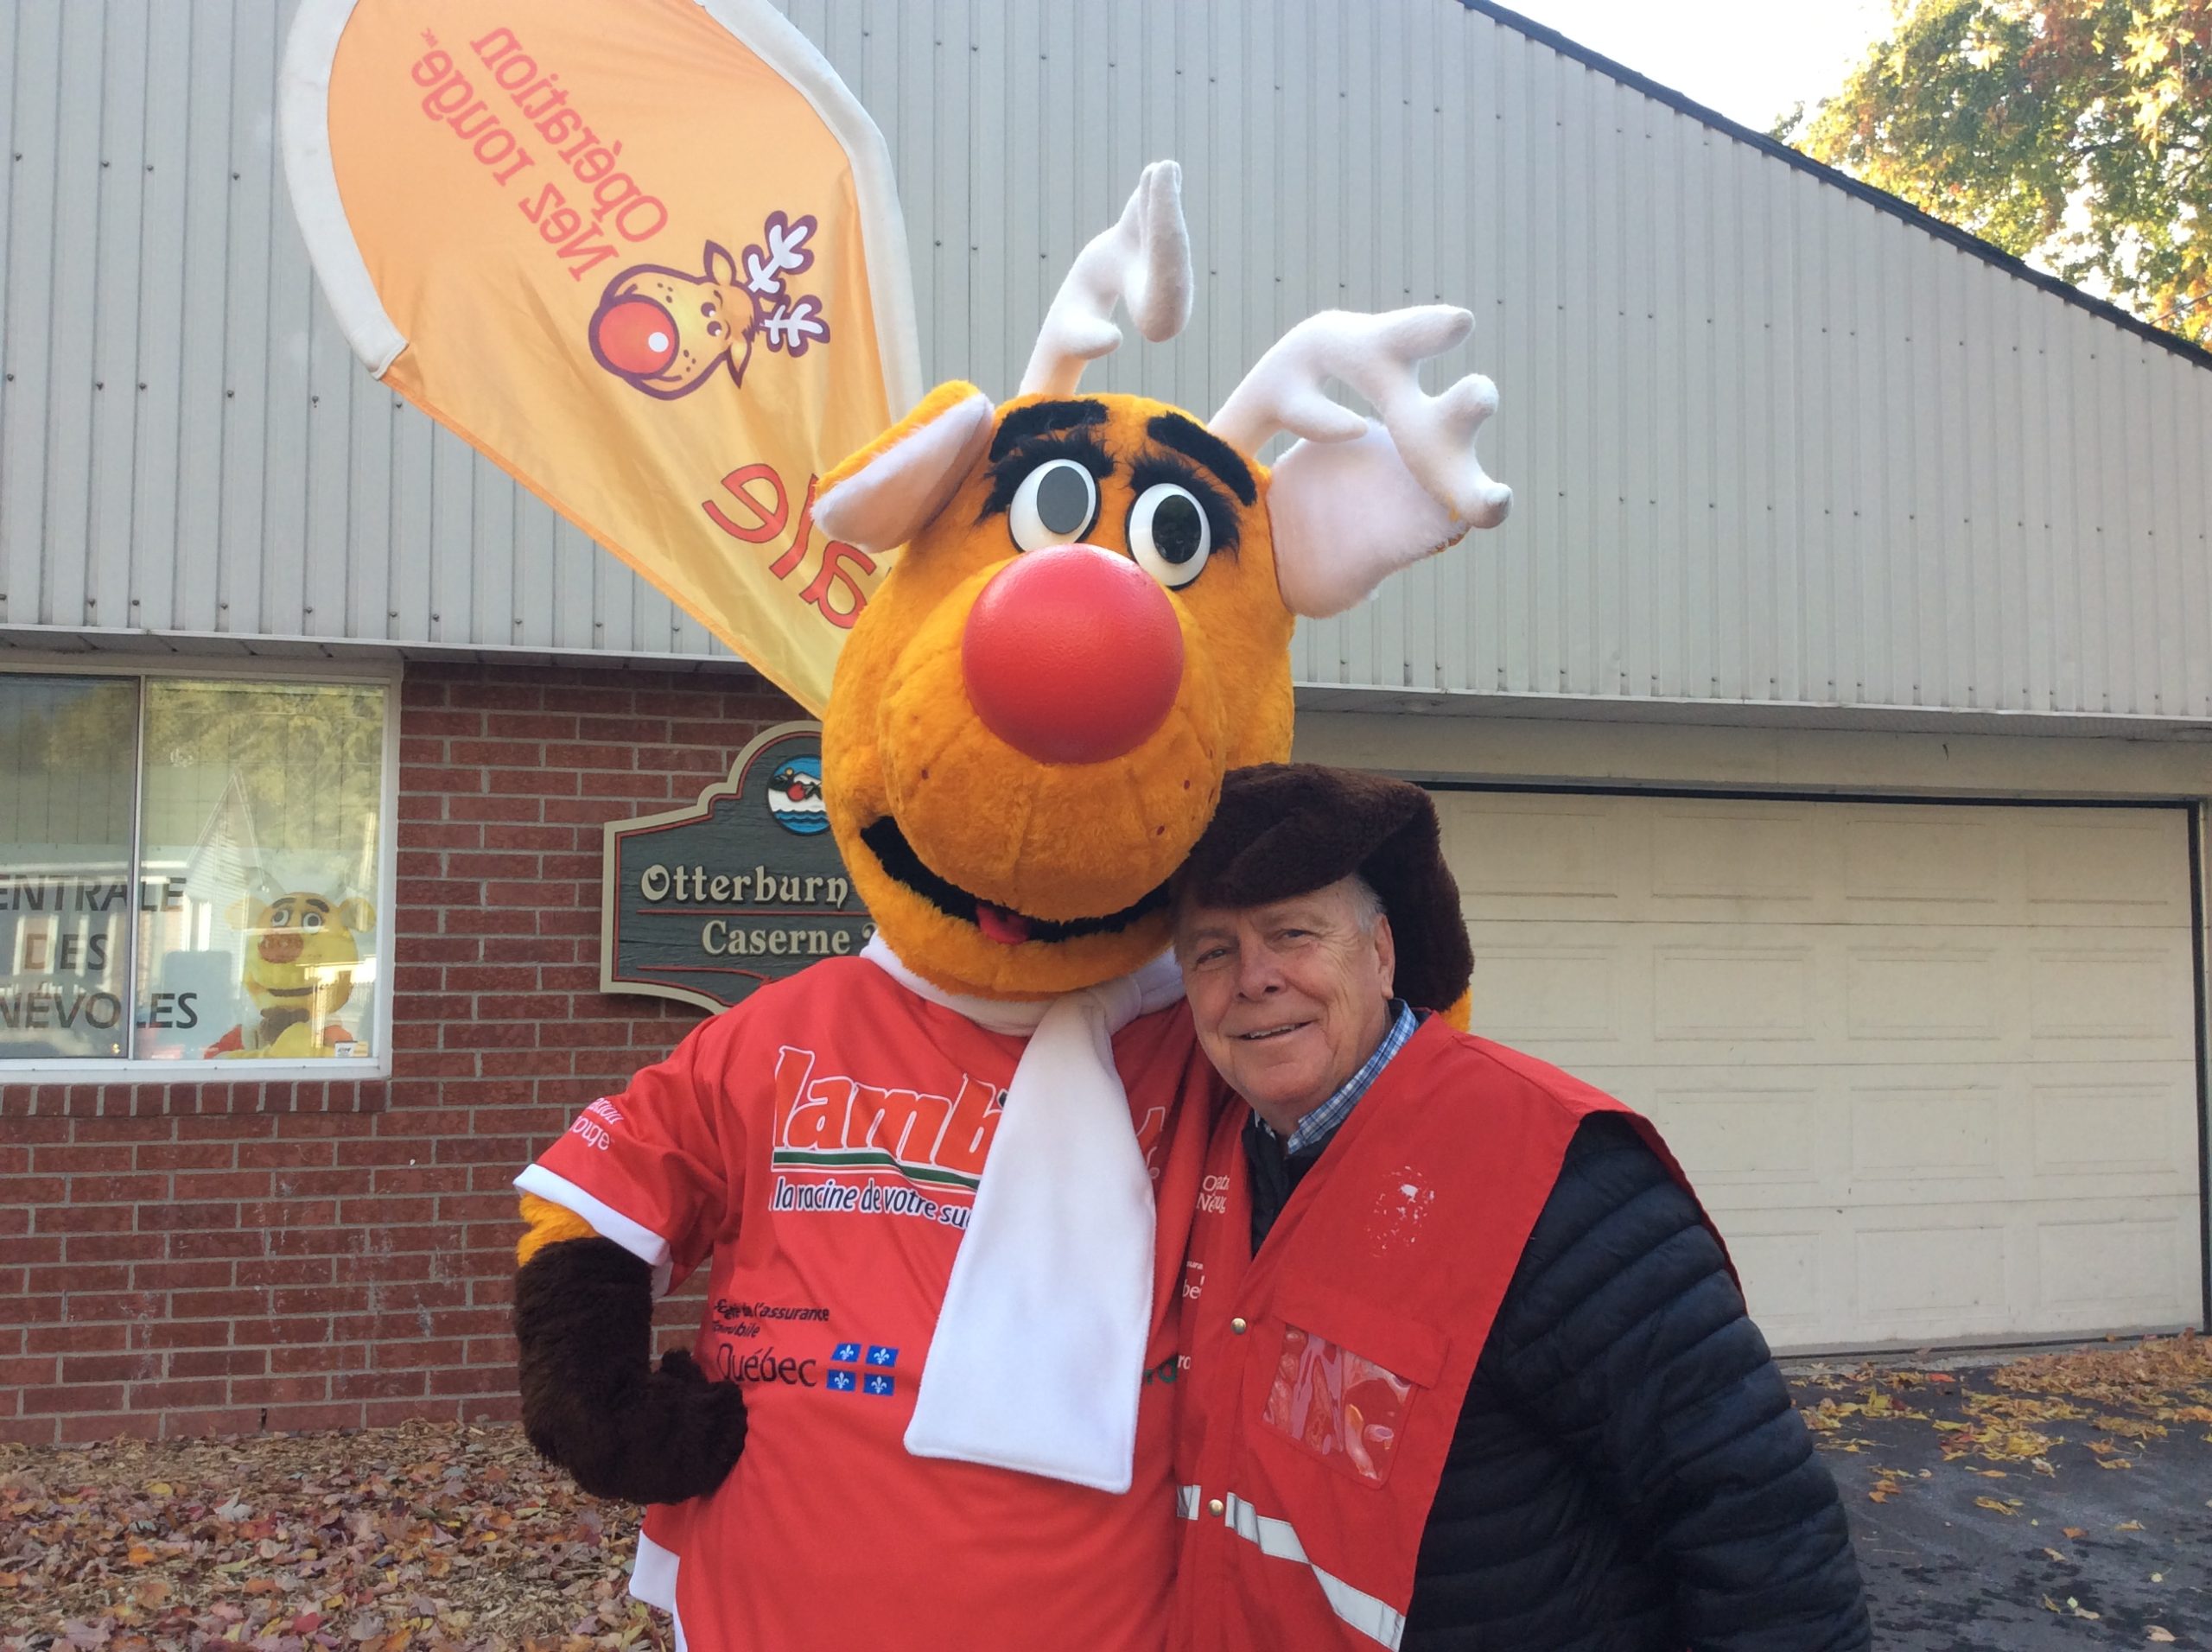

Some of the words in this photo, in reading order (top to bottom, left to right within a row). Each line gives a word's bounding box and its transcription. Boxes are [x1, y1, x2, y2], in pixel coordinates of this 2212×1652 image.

[702, 920, 851, 955] Caserne
[570, 1115, 610, 1151] ouge
[774, 1176, 794, 1210] la
[798, 1179, 857, 1210] racine
[861, 1177, 881, 1212] de
[884, 1186, 937, 1219] votre
[940, 1204, 973, 1229] su
[717, 1343, 817, 1388] Québec
